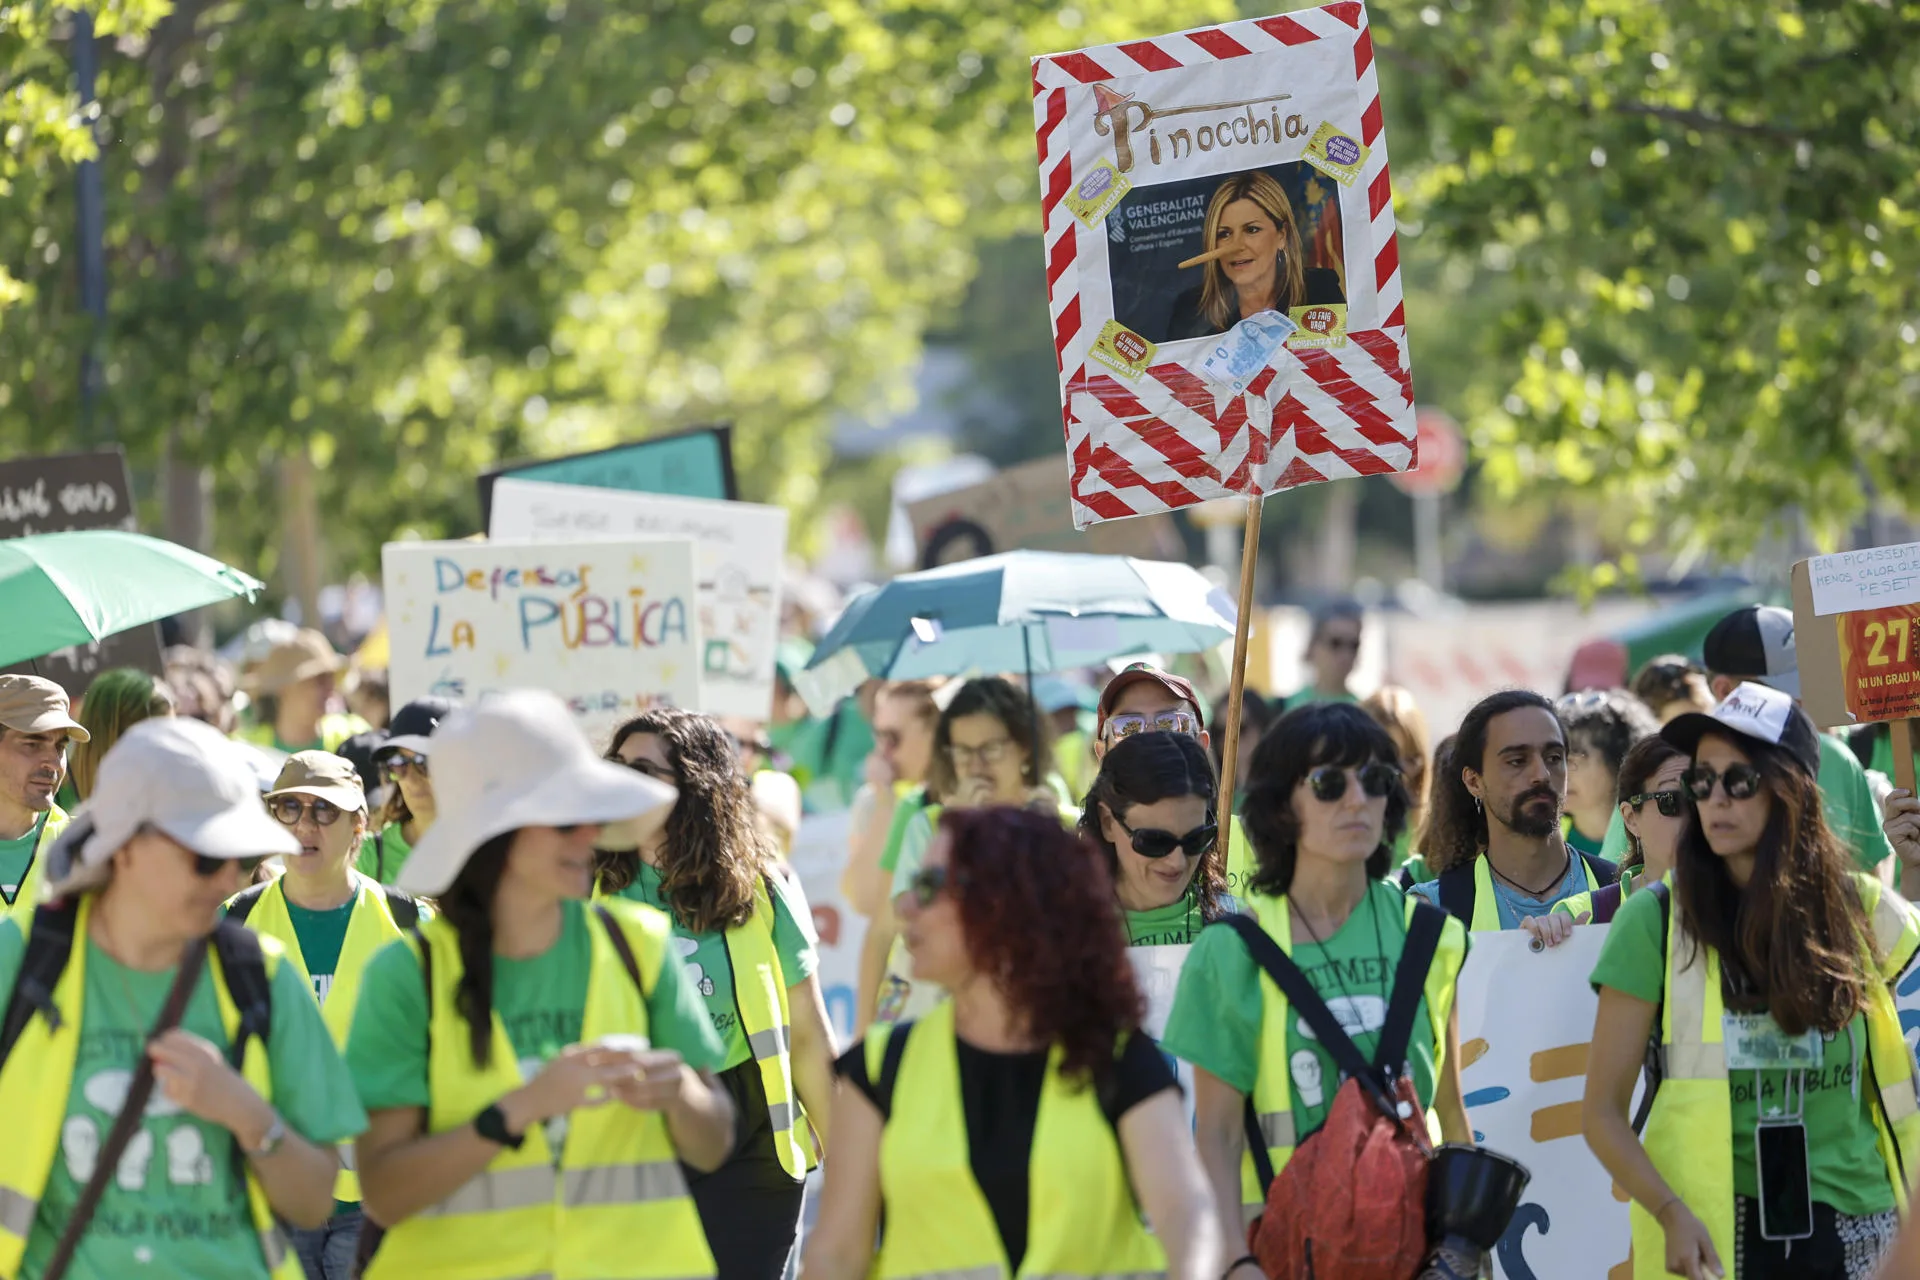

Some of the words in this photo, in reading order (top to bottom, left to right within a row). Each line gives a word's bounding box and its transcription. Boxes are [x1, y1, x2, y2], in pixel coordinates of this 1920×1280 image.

[1094, 101, 1308, 173] Pinocchia
[1126, 194, 1205, 219] GENERALITAT
[1128, 208, 1205, 230] VALENCIANA
[1814, 557, 1834, 571] EN
[1816, 572, 1854, 587] MENOS
[1858, 565, 1896, 579] CALOR
[1856, 575, 1917, 598] PESET
[1864, 618, 1910, 666] 27
[1858, 677, 1868, 688] NI
[1870, 675, 1883, 687] UN
[1885, 671, 1910, 685] GRAU
